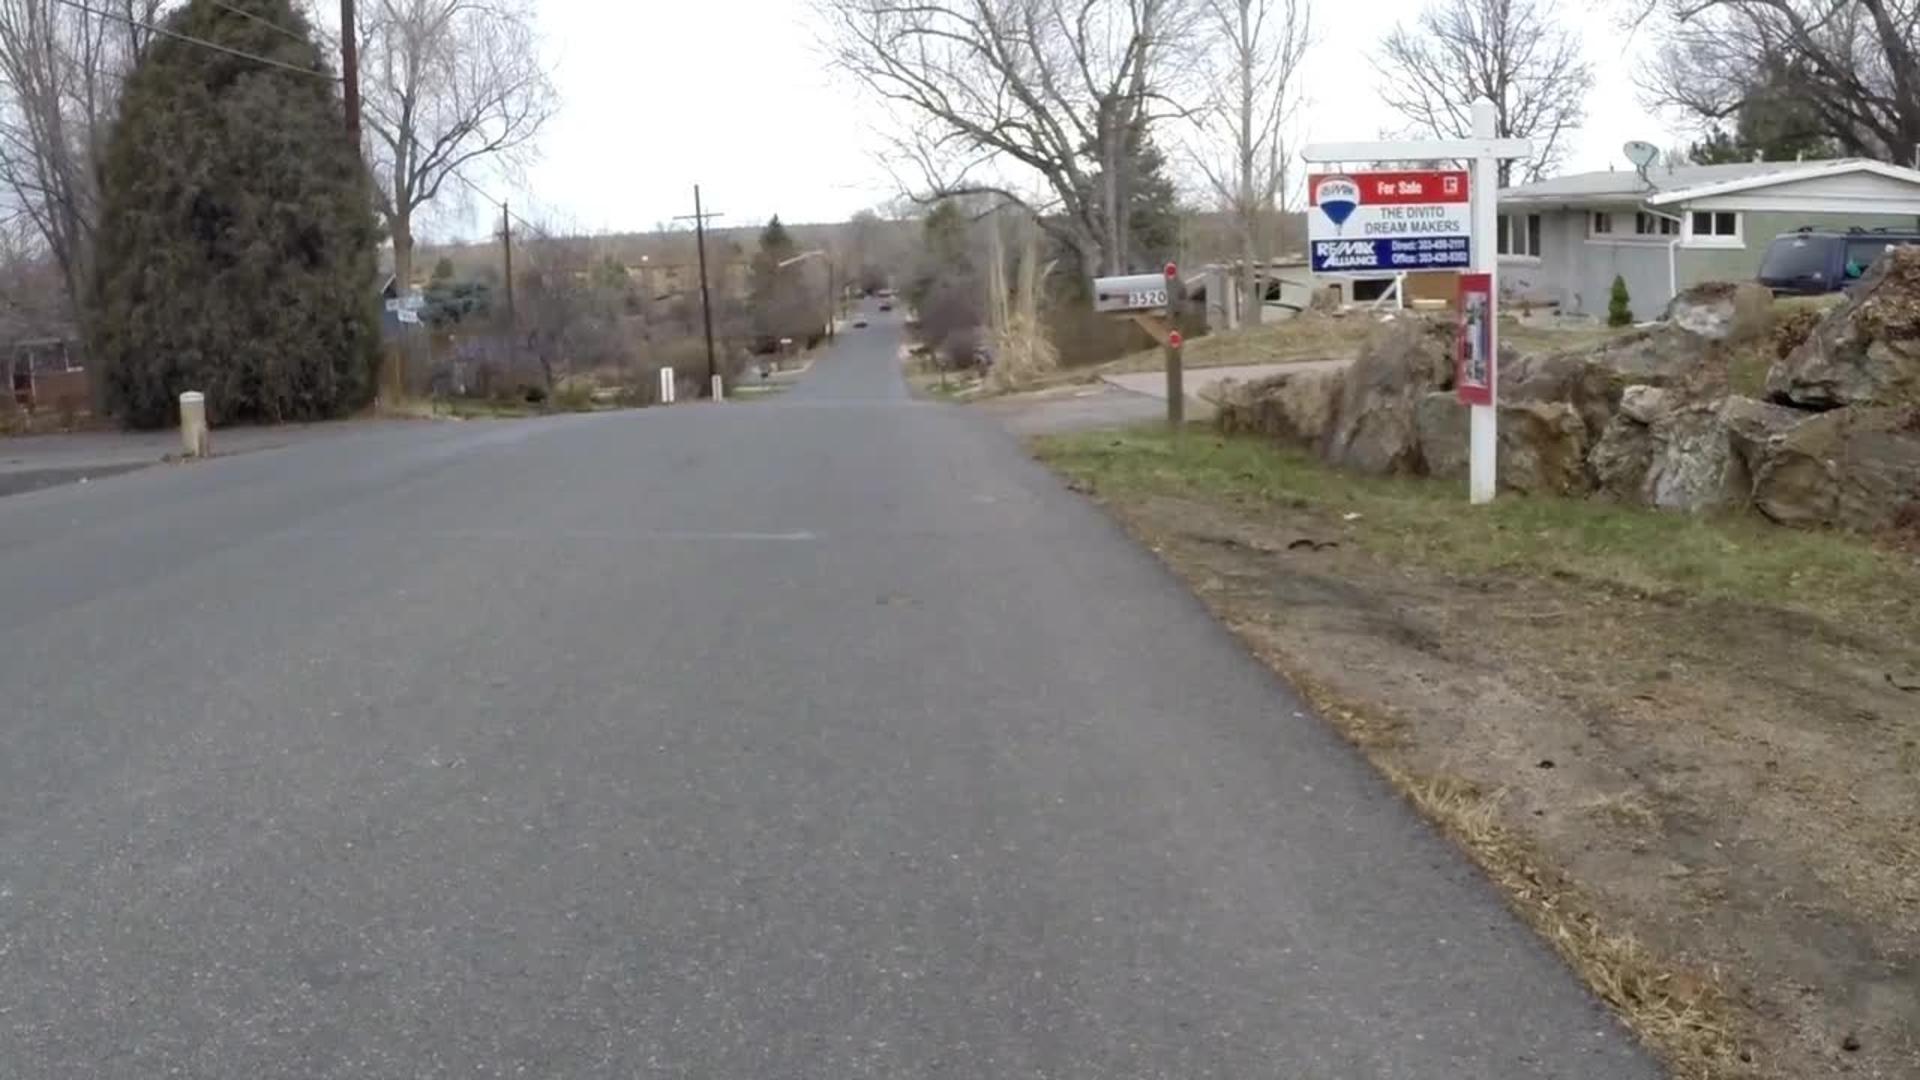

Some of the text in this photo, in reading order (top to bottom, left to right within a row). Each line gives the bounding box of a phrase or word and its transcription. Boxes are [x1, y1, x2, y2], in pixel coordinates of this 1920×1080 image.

[1377, 180, 1422, 195] For Sale
[1380, 206, 1445, 219] THE DIVITO
[1364, 220, 1460, 235] DREAM MAKERS
[1131, 291, 1166, 304] 3520
